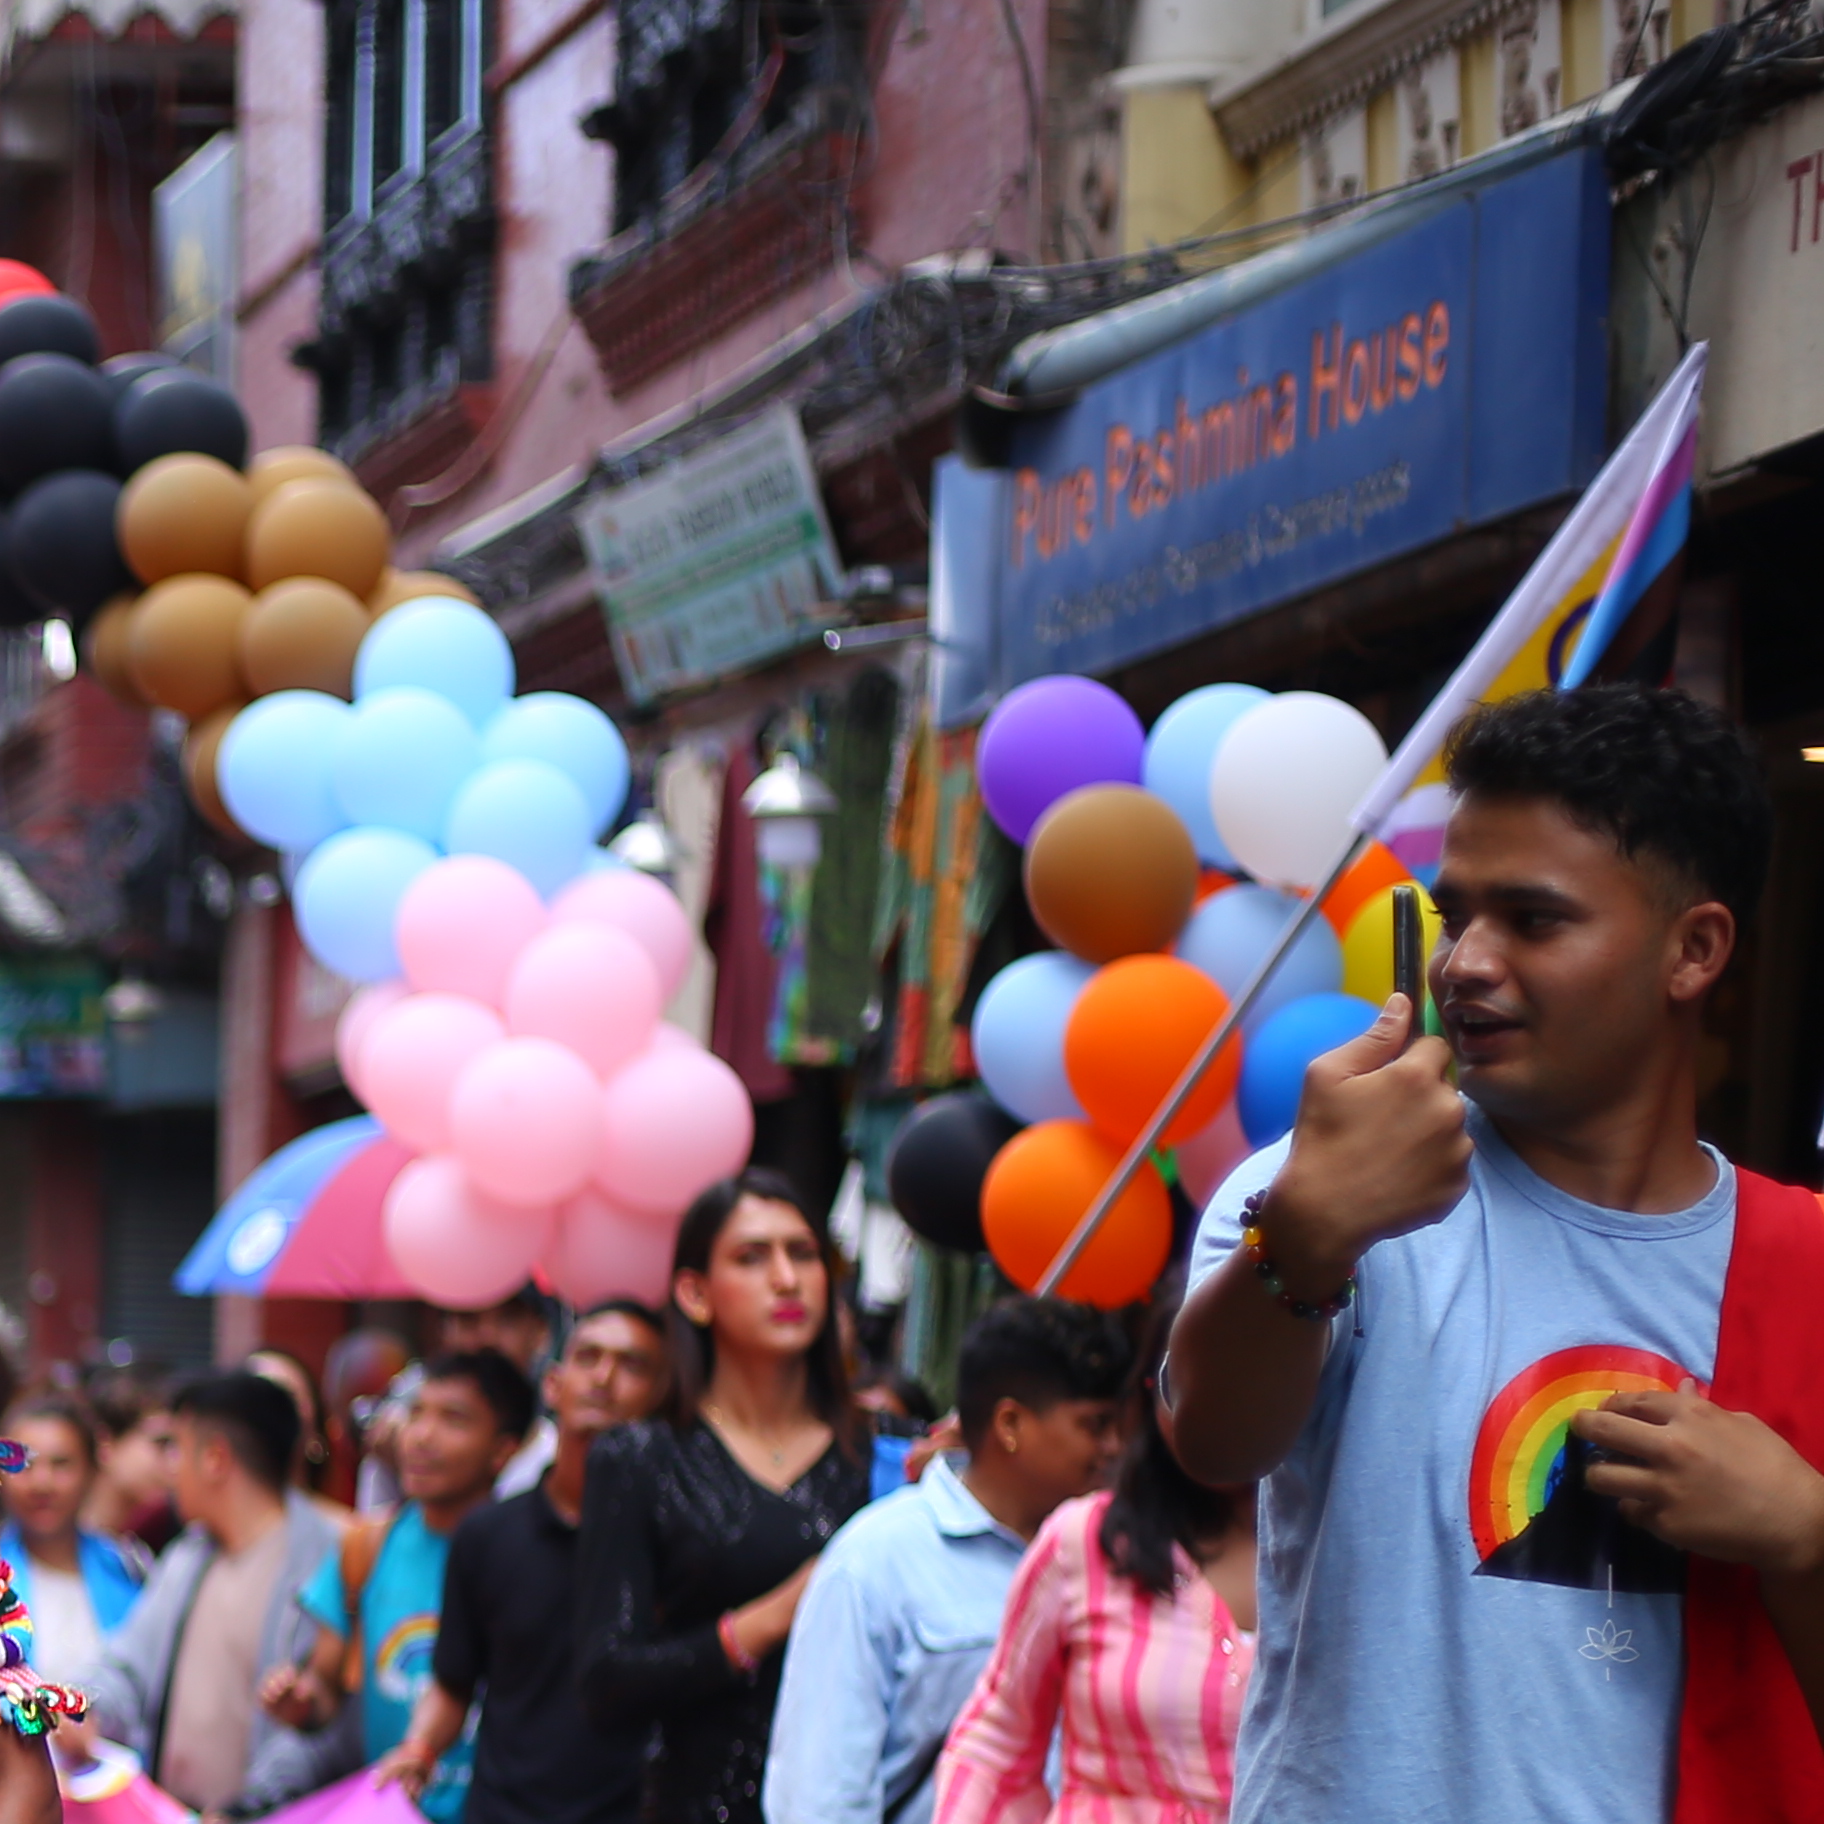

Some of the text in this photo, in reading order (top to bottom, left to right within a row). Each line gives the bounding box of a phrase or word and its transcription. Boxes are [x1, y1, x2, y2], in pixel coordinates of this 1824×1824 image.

[1011, 466, 1097, 570] Pure
[1104, 366, 1297, 530] Pashmina
[1307, 301, 1450, 441] House
